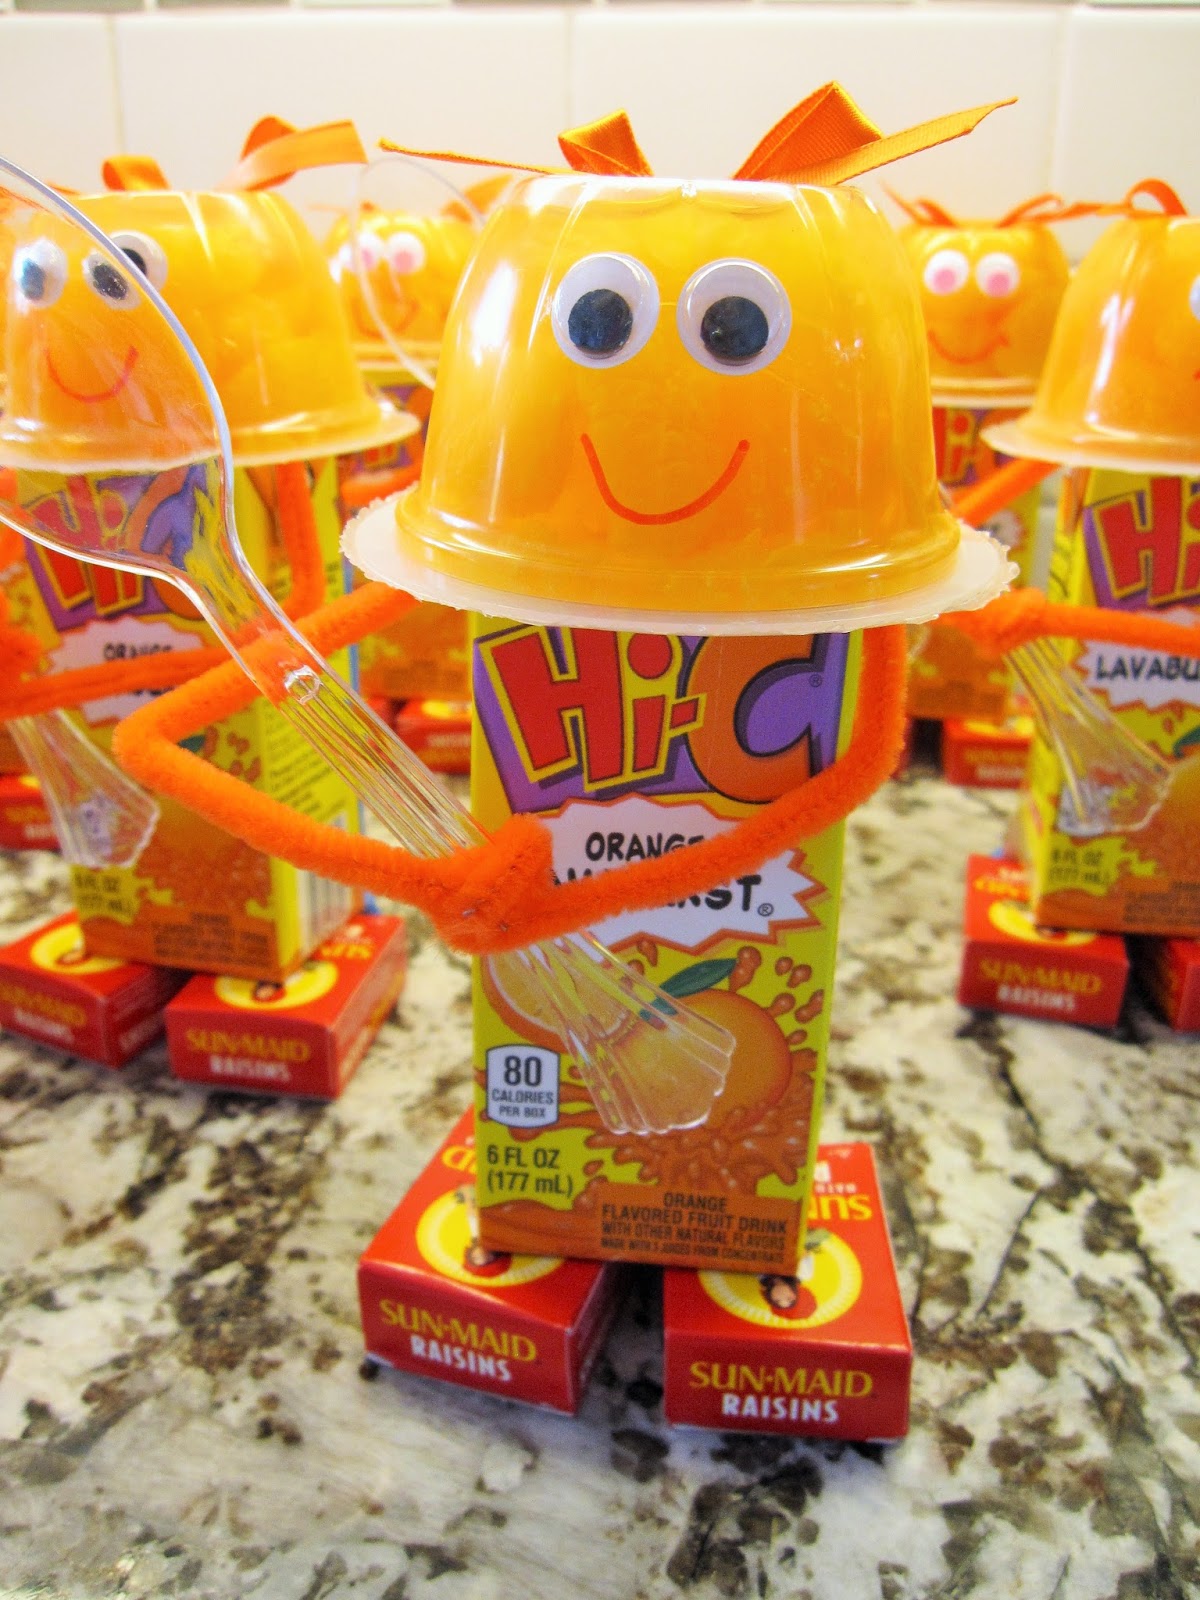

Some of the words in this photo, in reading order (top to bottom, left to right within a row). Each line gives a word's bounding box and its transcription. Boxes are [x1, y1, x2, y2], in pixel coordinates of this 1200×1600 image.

[1096, 653, 1200, 681] LAVABU
[478, 625, 824, 804] Hi-C
[585, 831, 704, 862] ORANG
[504, 1055, 542, 1087] 80
[491, 1087, 554, 1104] CALORIES
[500, 1105, 520, 1118] PER
[524, 1106, 546, 1119] BOX
[487, 1144, 498, 1165] 6
[504, 1145, 528, 1168] FL
[533, 1148, 560, 1170] OZ
[487, 1168, 529, 1194] (177
[535, 1173, 573, 1198] mL)
[663, 1192, 727, 1212] ORANGE
[602, 1203, 683, 1225] FLAVORED
[688, 1211, 733, 1229] FRUIT
[738, 1216, 787, 1234] DRINK
[602, 1220, 632, 1236] WITH
[634, 1223, 672, 1240] OTHER
[676, 1228, 728, 1245] NATURAL
[410, 1334, 512, 1382] RAISINS
[721, 1393, 839, 1425] RAISINS
